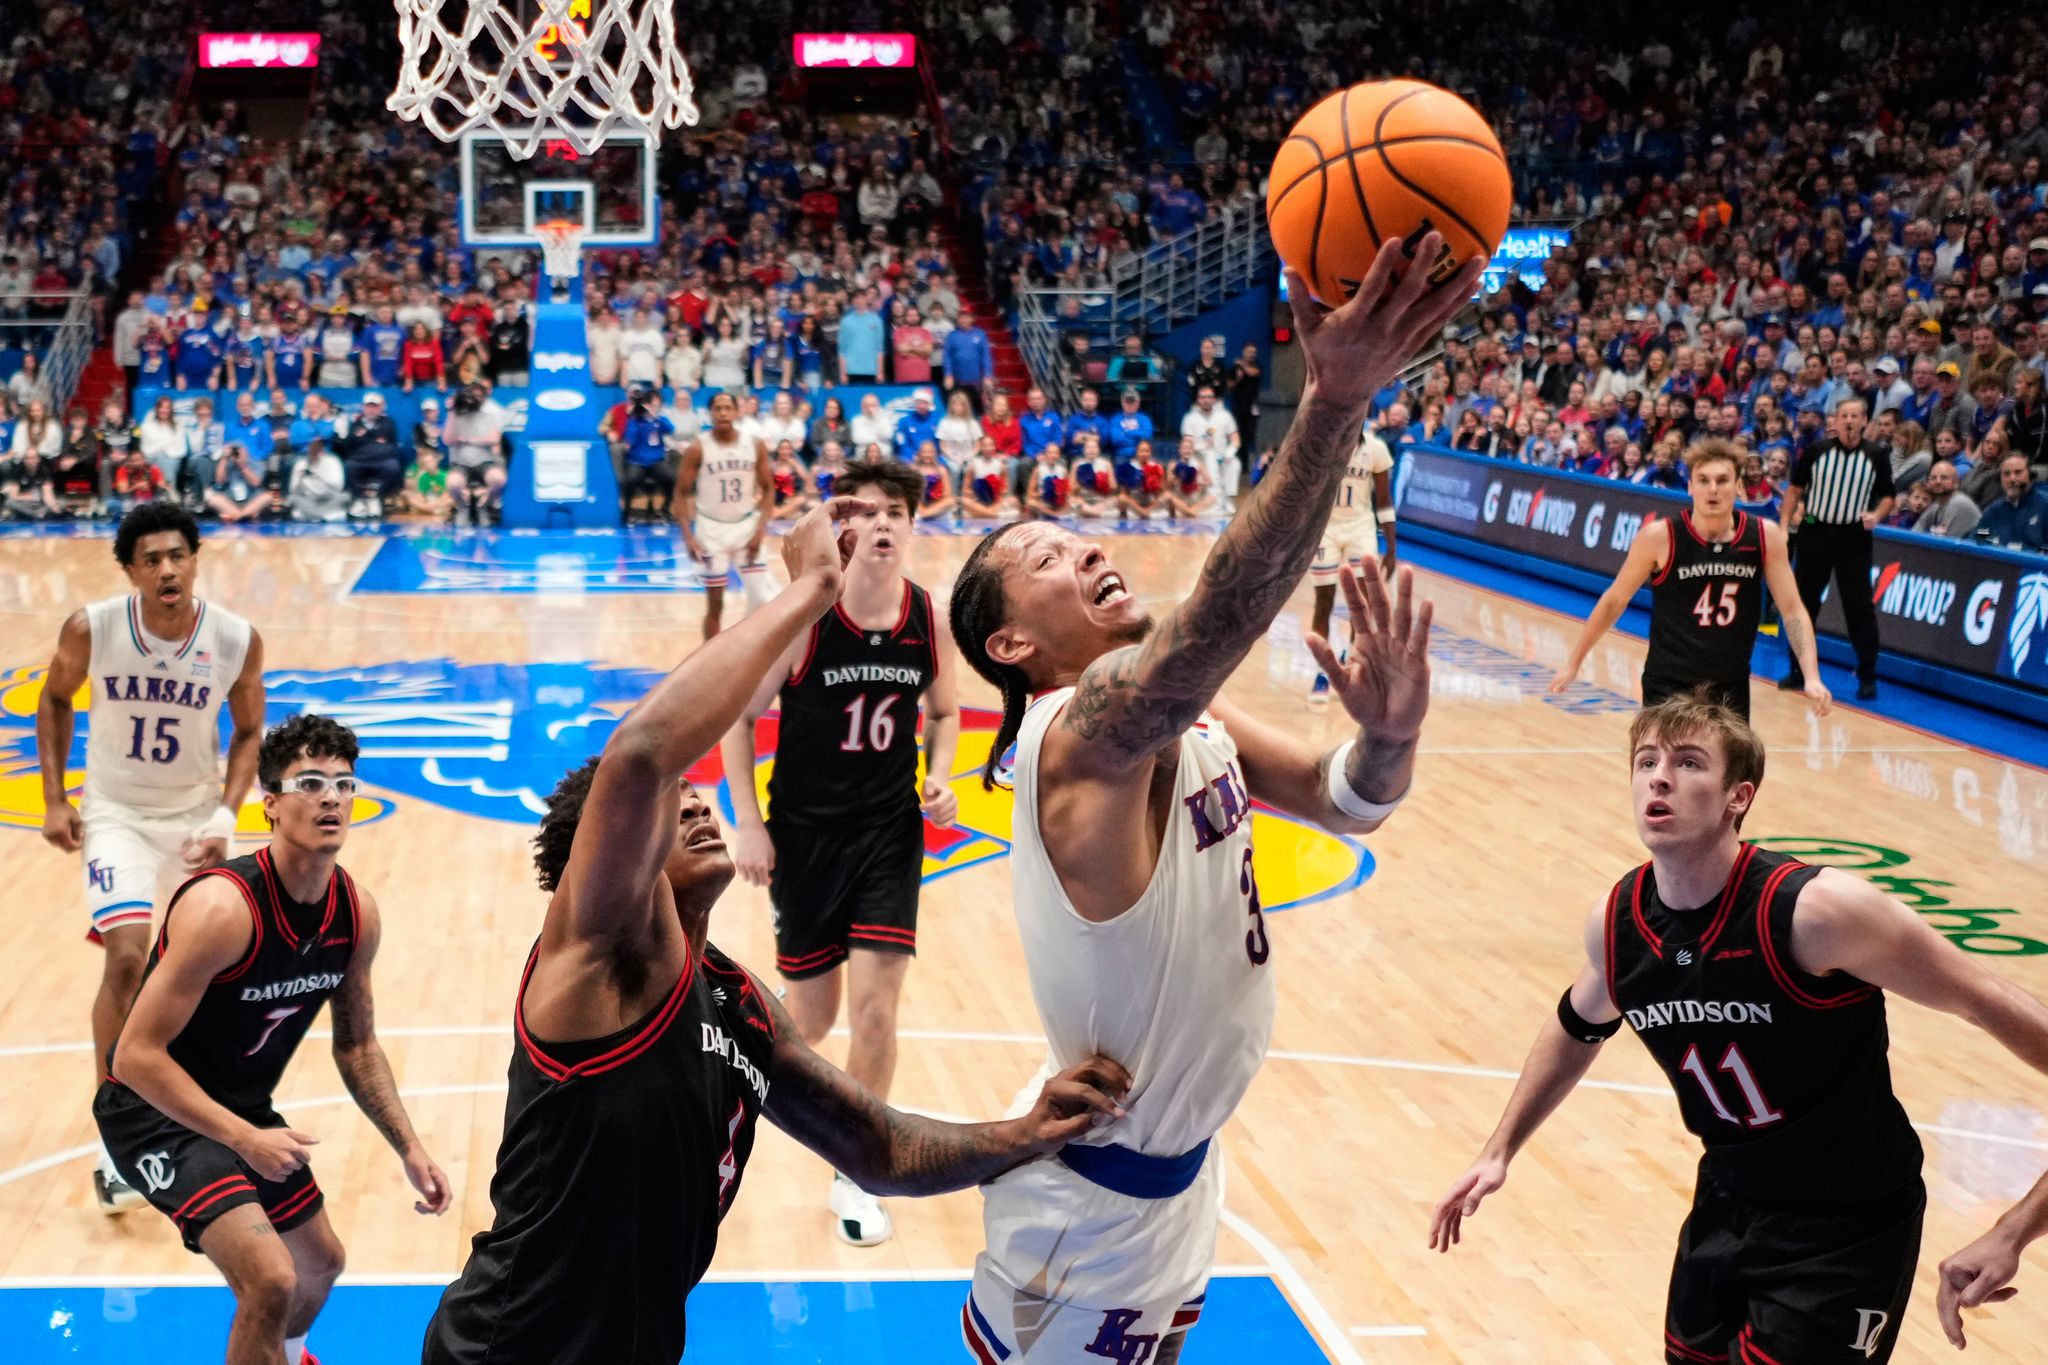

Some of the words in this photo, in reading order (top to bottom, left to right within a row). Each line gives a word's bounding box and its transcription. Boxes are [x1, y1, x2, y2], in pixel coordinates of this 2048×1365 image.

[719, 478, 742, 504] 13
[1483, 481, 1503, 523] G
[1583, 502, 1605, 549] G
[1678, 562, 1757, 580] DAVIDSON
[1692, 581, 1740, 627] 45
[1964, 579, 2004, 646] G
[103, 675, 211, 710] KANSAS
[823, 665, 922, 687] DAVIDSON
[126, 715, 181, 764] 15
[840, 691, 901, 752] 16
[88, 858, 115, 894] KU
[1240, 848, 1270, 968] 3
[240, 973, 345, 1002] DAVIDSON
[242, 1003, 304, 1057] 7
[1626, 1000, 1774, 1032] DAVIDSON
[1679, 1041, 1786, 1130] 11
[135, 1150, 176, 1195] DC
[717, 1096, 745, 1208] 4
